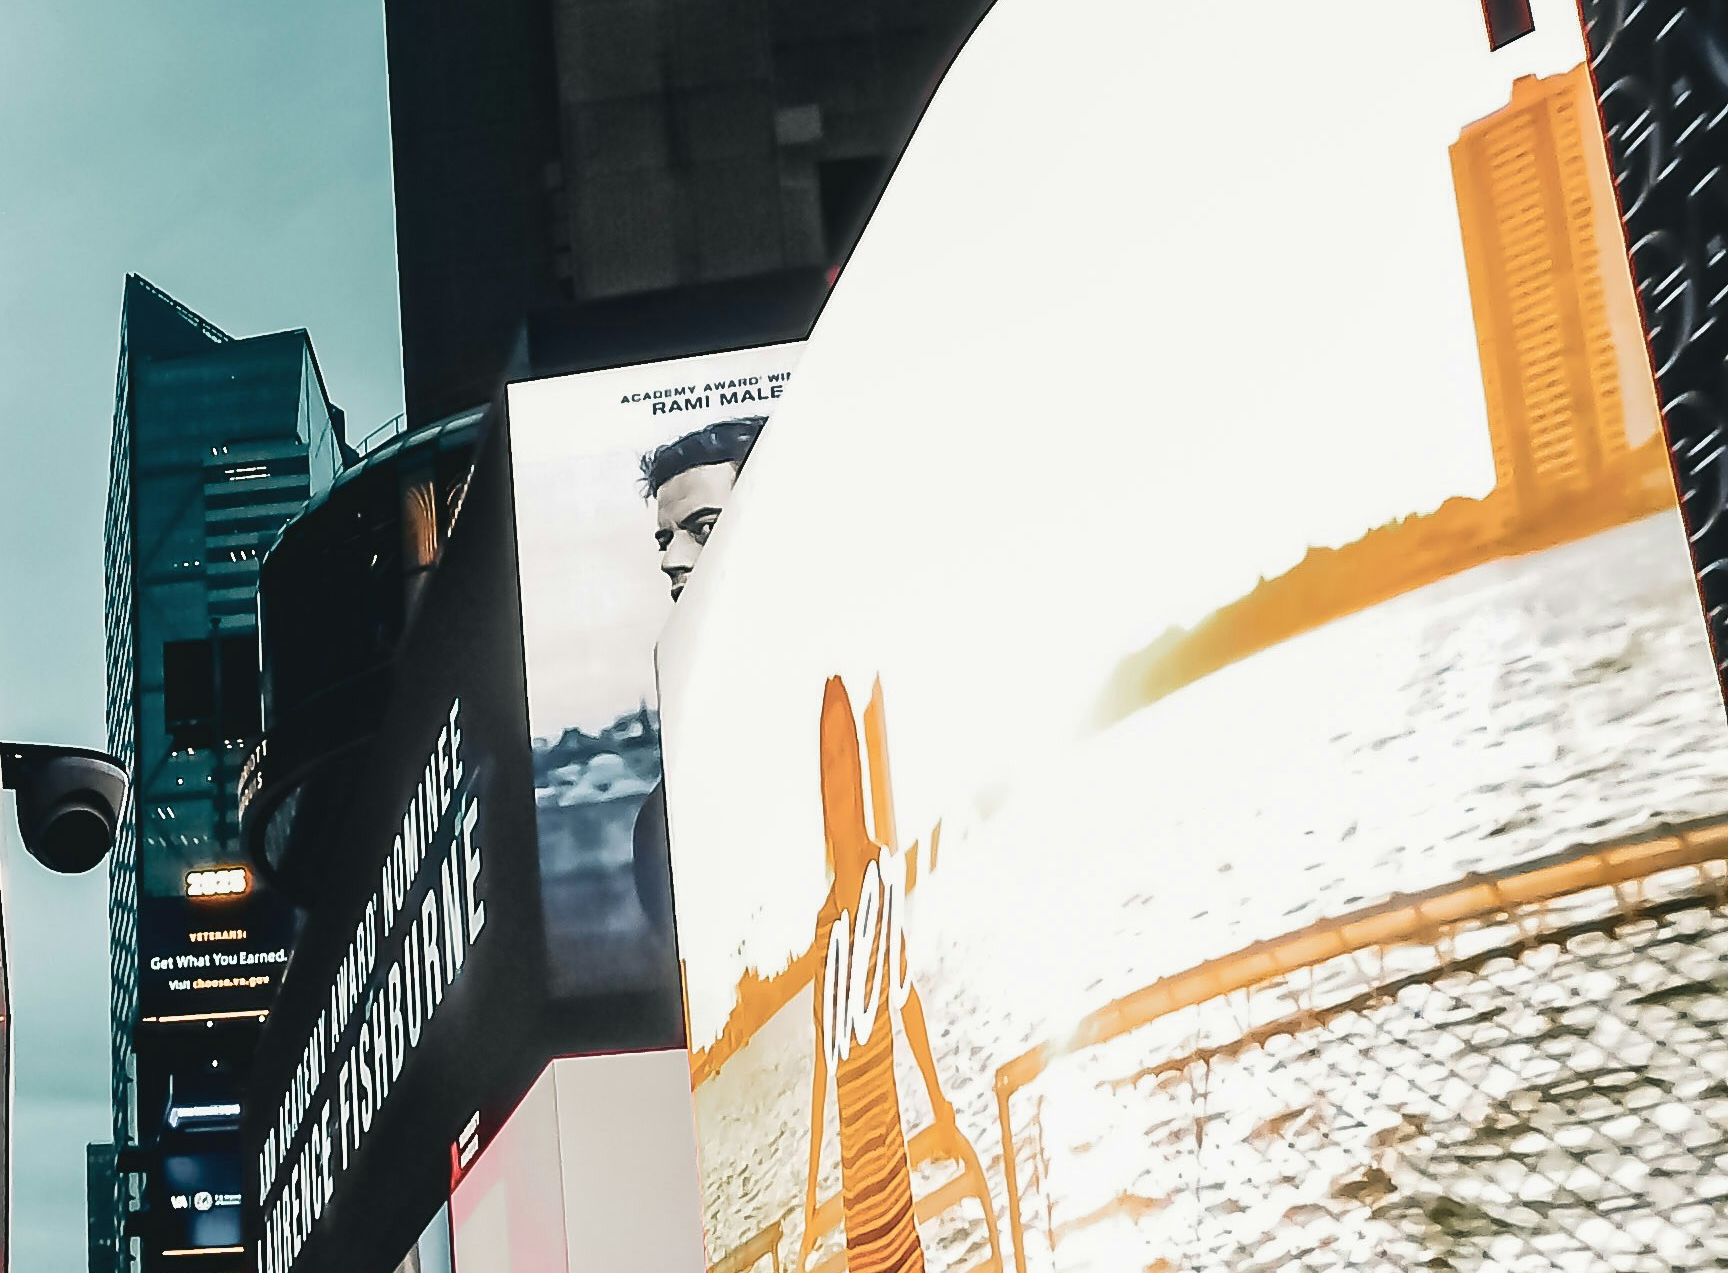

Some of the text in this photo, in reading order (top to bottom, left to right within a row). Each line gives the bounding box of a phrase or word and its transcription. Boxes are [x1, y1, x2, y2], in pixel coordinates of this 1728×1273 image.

[621, 385, 696, 404] ACADEMY
[652, 385, 784, 416] RAMI MALE
[279, 1009, 326, 1164] ACADEMY
[382, 694, 464, 938] NOMINEE
[150, 948, 288, 970] Get What You Earned.
[168, 980, 191, 991] Visit
[339, 796, 485, 1171] FISHBURNE
